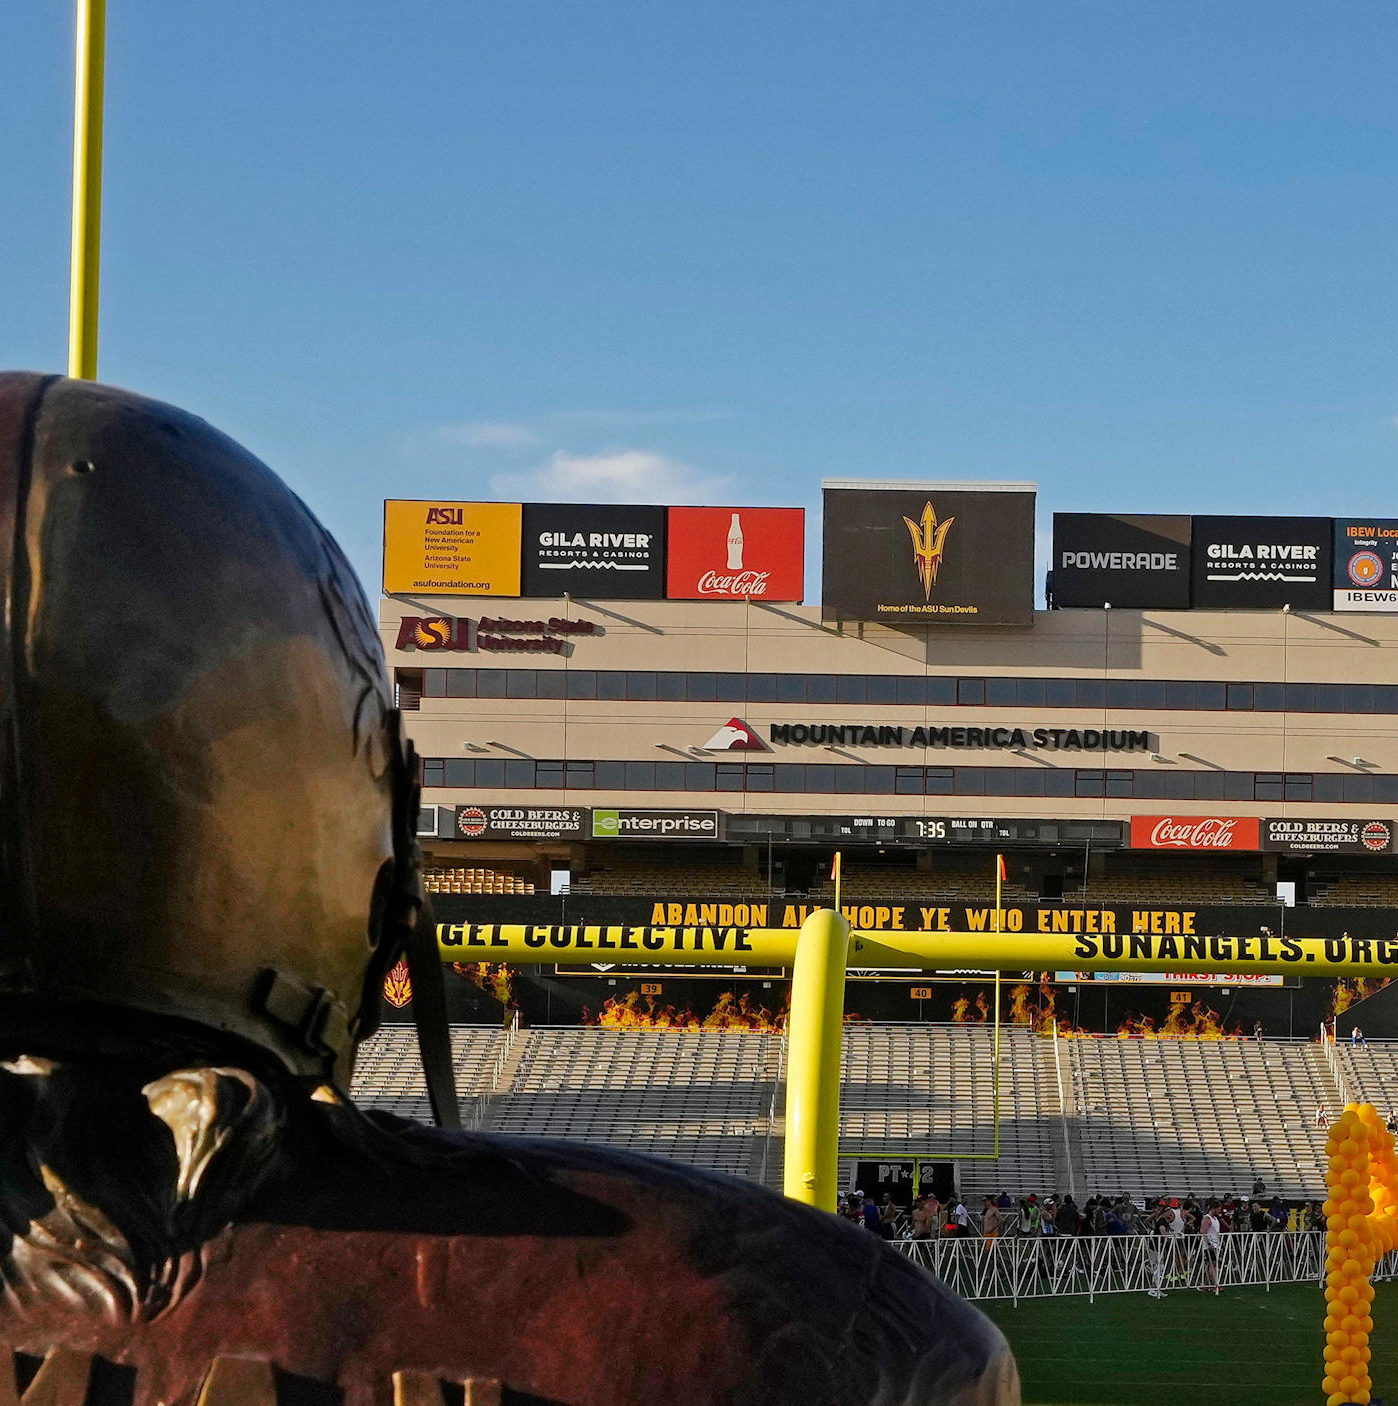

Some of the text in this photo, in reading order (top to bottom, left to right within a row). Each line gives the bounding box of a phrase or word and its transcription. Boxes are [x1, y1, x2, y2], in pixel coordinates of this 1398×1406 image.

[426, 508, 463, 525] ASU
[424, 529, 464, 537] Foundation
[1346, 527, 1375, 537] IBEW
[539, 532, 651, 548] GILA RIVER
[1354, 539, 1378, 547] Integrity
[424, 544, 459, 552] University
[1207, 544, 1316, 560] GILA RIVER
[452, 555, 472, 563] State
[1062, 551, 1177, 570] POWERADE
[424, 562, 459, 571] University
[413, 579, 491, 591] asufoundation.org
[697, 570, 771, 595] Coca-Cola
[877, 604, 979, 614] Home of the ASU Sun Devils
[477, 616, 595, 634] Arizona State
[395, 616, 469, 651] ASU
[477, 634, 564, 654] University
[770, 723, 1149, 750] MOUNTAIN AMERICA STADIUM
[489, 809, 581, 821] COLD BEERS &
[490, 821, 580, 831] CHEESEBURGERS
[601, 815, 715, 834] enterprise
[853, 818, 896, 827] DOWN TO GO
[952, 820, 994, 830] BALL ON QTR
[1269, 821, 1360, 834] COLD BEERS &
[915, 821, 946, 839] 7:35
[999, 829, 1010, 837] TOL
[1150, 818, 1238, 848] Coca-Cola
[1269, 832, 1359, 844] CHEESEBURGERS
[651, 903, 1196, 935] ABANDON AL HOPE YE WHO ENTER HERE
[524, 926, 752, 951] COLLECTIVE
[645, 985, 657, 993] 39
[915, 988, 927, 997] 40
[1175, 993, 1187, 1001] 41
[878, 1164, 901, 1183] PT
